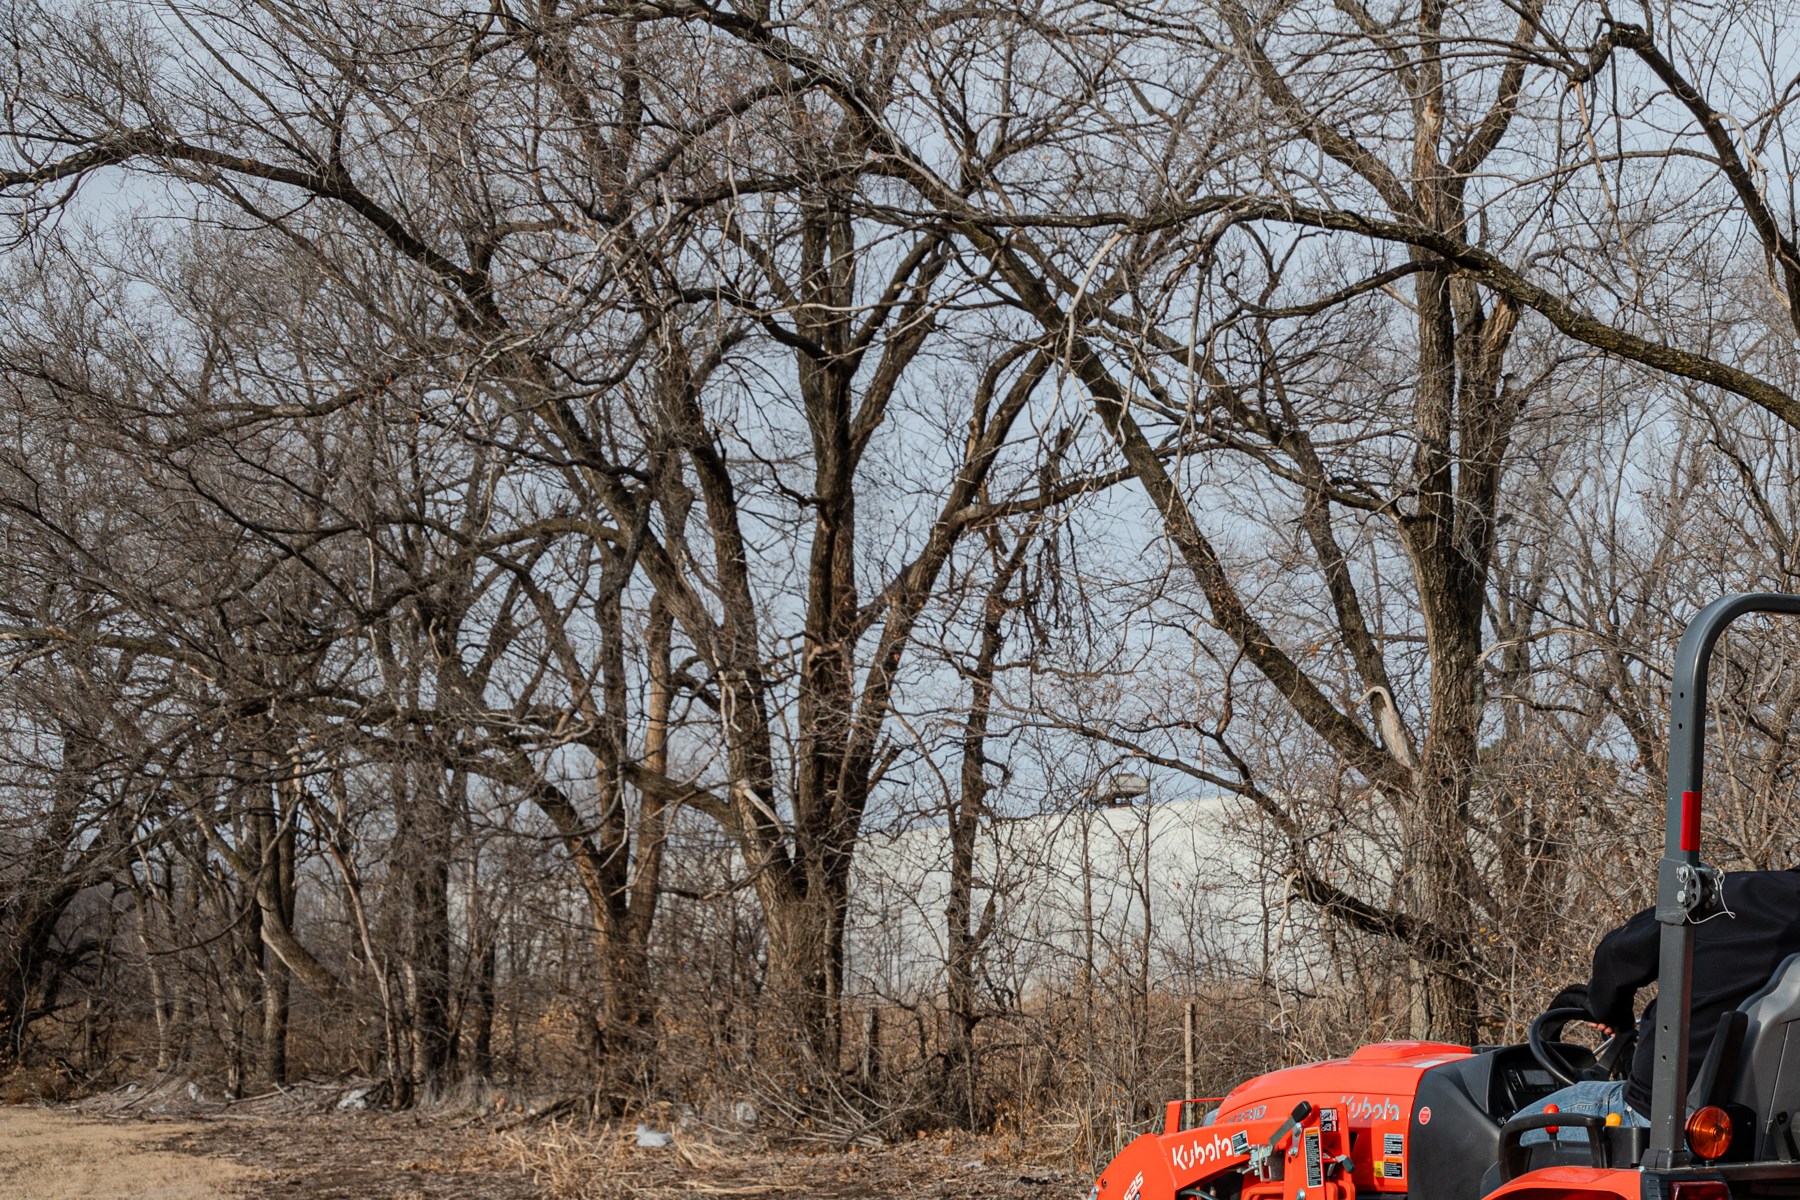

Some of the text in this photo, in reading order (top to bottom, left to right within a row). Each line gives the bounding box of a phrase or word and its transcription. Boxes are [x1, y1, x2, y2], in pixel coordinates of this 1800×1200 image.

[1222, 1104, 1266, 1123] 3310
[1341, 1096, 1399, 1121] Kubota
[1172, 1133, 1232, 1170] Kubota
